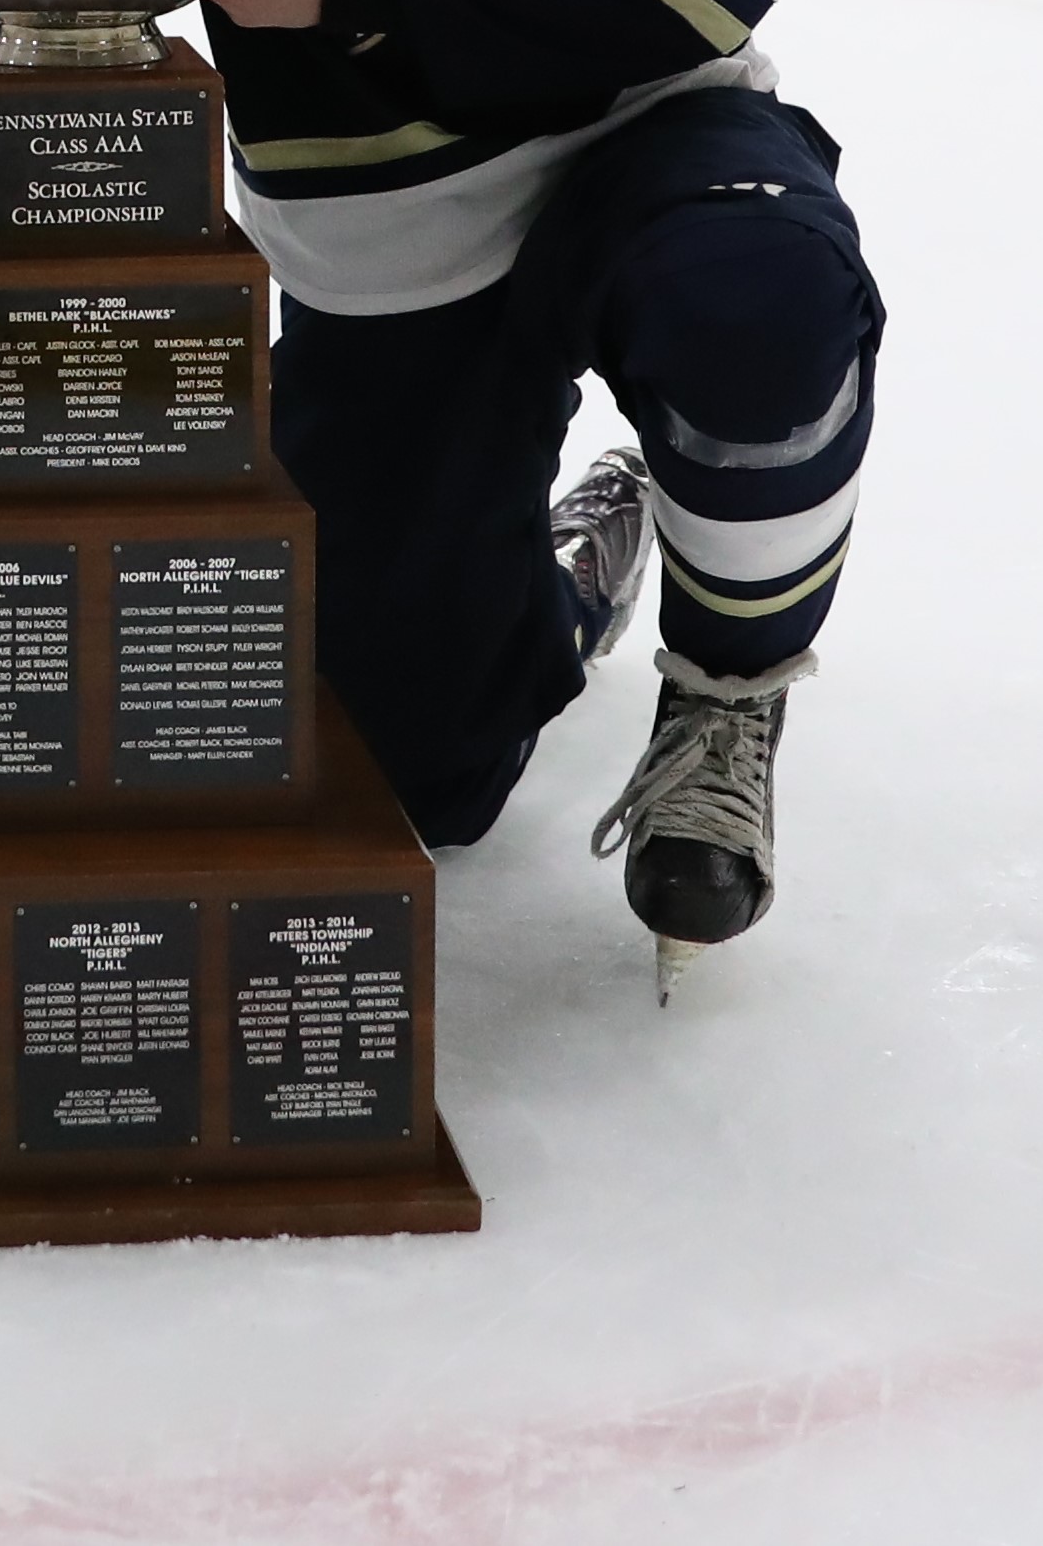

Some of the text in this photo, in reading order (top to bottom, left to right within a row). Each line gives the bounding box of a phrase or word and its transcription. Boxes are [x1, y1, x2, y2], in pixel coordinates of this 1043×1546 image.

[60, 299, 87, 308] 1999
[98, 298, 126, 308] 2000
[9, 310, 176, 322] BETHEL PARK "BLACKHAWKS"
[73, 323, 112, 333] P.I.H.L.
[169, 353, 197, 361] JASON
[57, 369, 97, 377] BRANDON
[176, 367, 196, 375] TONY
[68, 410, 86, 418] DAN
[165, 408, 199, 416] ANDREW
[173, 421, 186, 430] LEE
[42, 434, 64, 442] HEAD
[65, 433, 96, 441] COACH
[20, 447, 59, 455] COACHES
[47, 459, 86, 467] PRESIDENT
[169, 559, 198, 569] 2006
[208, 558, 236, 568] 2007
[23, 575, 68, 585] DEVILS"
[120, 570, 285, 582] NORTH ALLEGHENY "TIGERS"
[183, 583, 222, 593] P.I.H.L.
[287, 918, 315, 928] 2013
[326, 917, 355, 927] 2014
[71, 924, 101, 934] 2012
[111, 923, 140, 933] 2013
[269, 929, 374, 941] PETERS TOWNSHIP
[49, 935, 164, 947] NORTH ALLEGHENY
[290, 942, 353, 952] "INDIANS"
[81, 948, 133, 958] "TIGERS"
[301, 955, 341, 964] P.I.H.L.
[87, 961, 126, 971] P.I.H.L.
